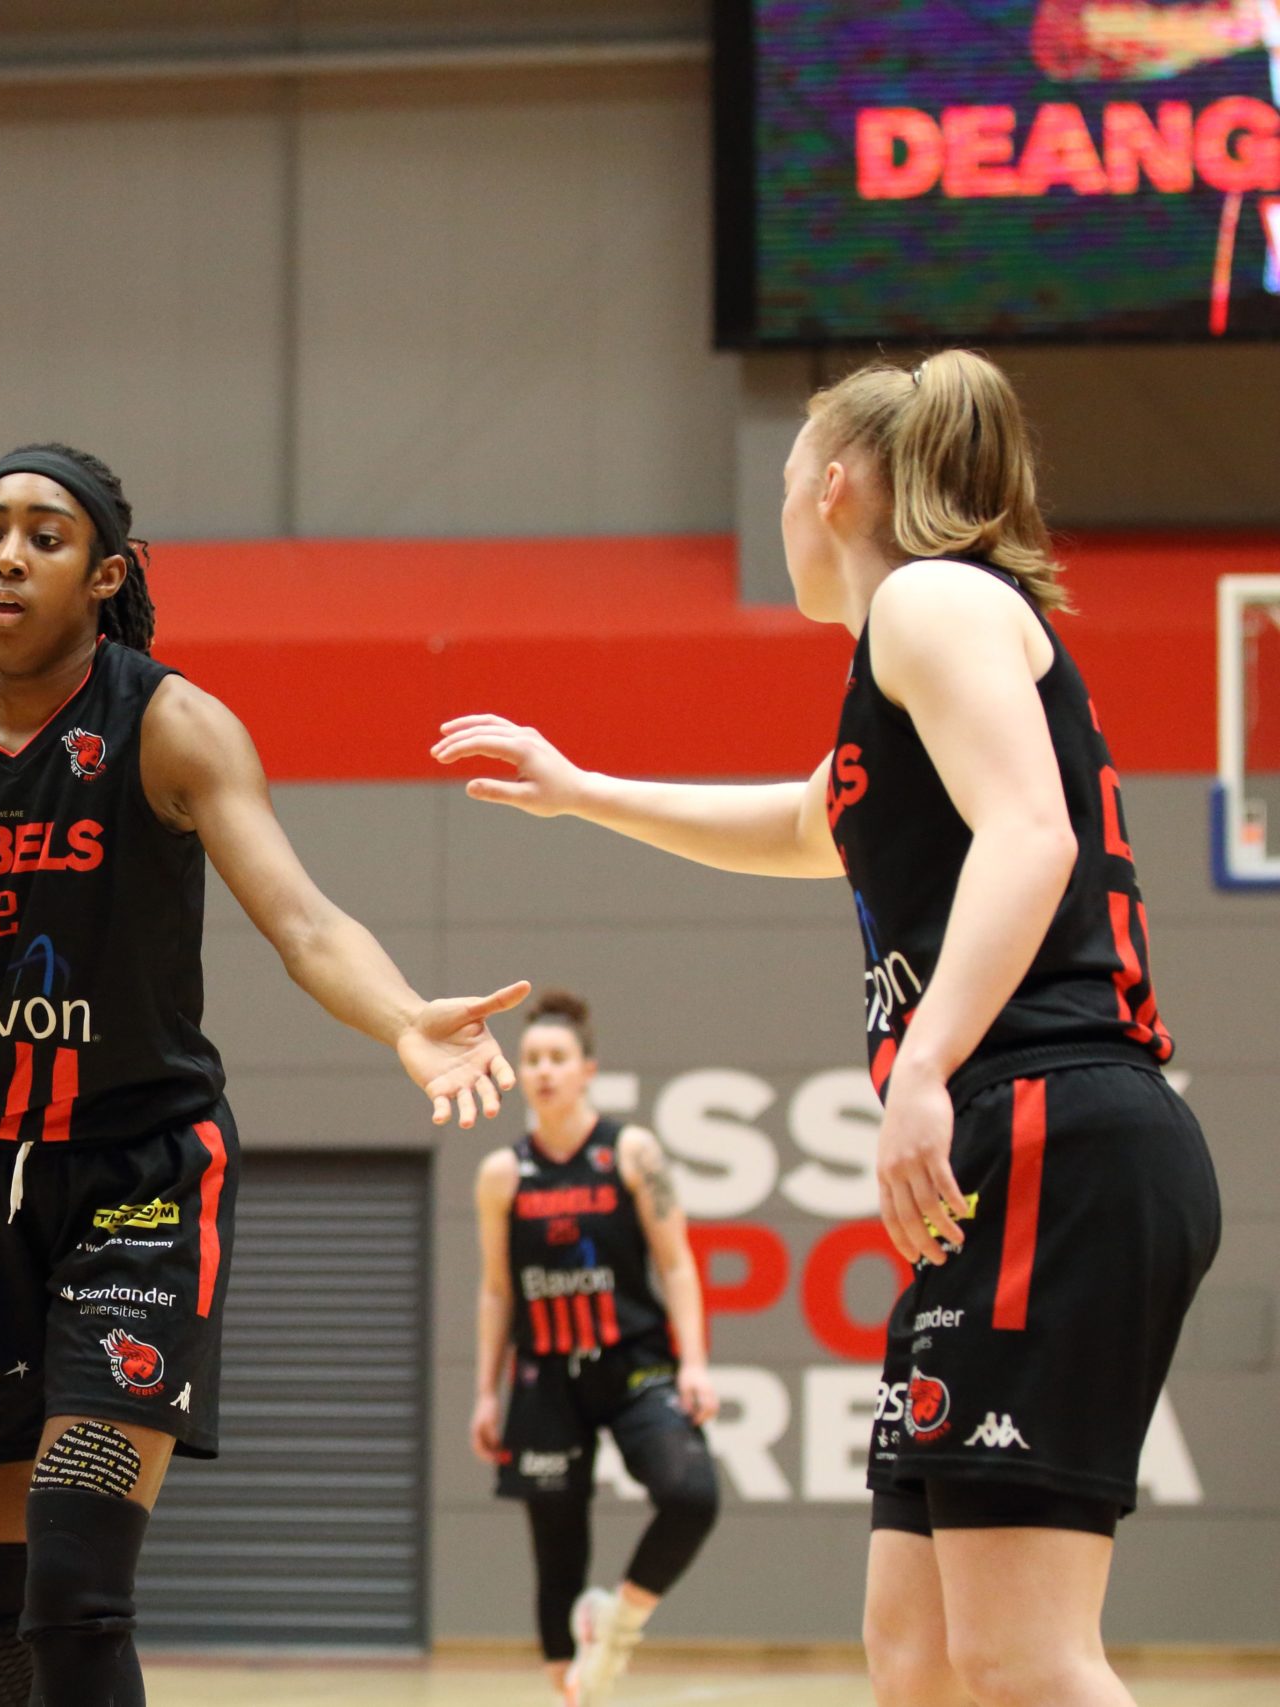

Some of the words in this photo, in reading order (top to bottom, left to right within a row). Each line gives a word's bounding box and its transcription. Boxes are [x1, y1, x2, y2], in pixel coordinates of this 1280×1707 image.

[855, 96, 1280, 199] DEANG
[10, 809, 25, 818] ARE
[124, 1238, 174, 1248] Company
[110, 1358, 128, 1389] ESSEX
[86, 1431, 119, 1446] SPORTTAPE
[73, 1449, 108, 1463] SPORTTAPE
[102, 1447, 132, 1464] SPORTTAPE
